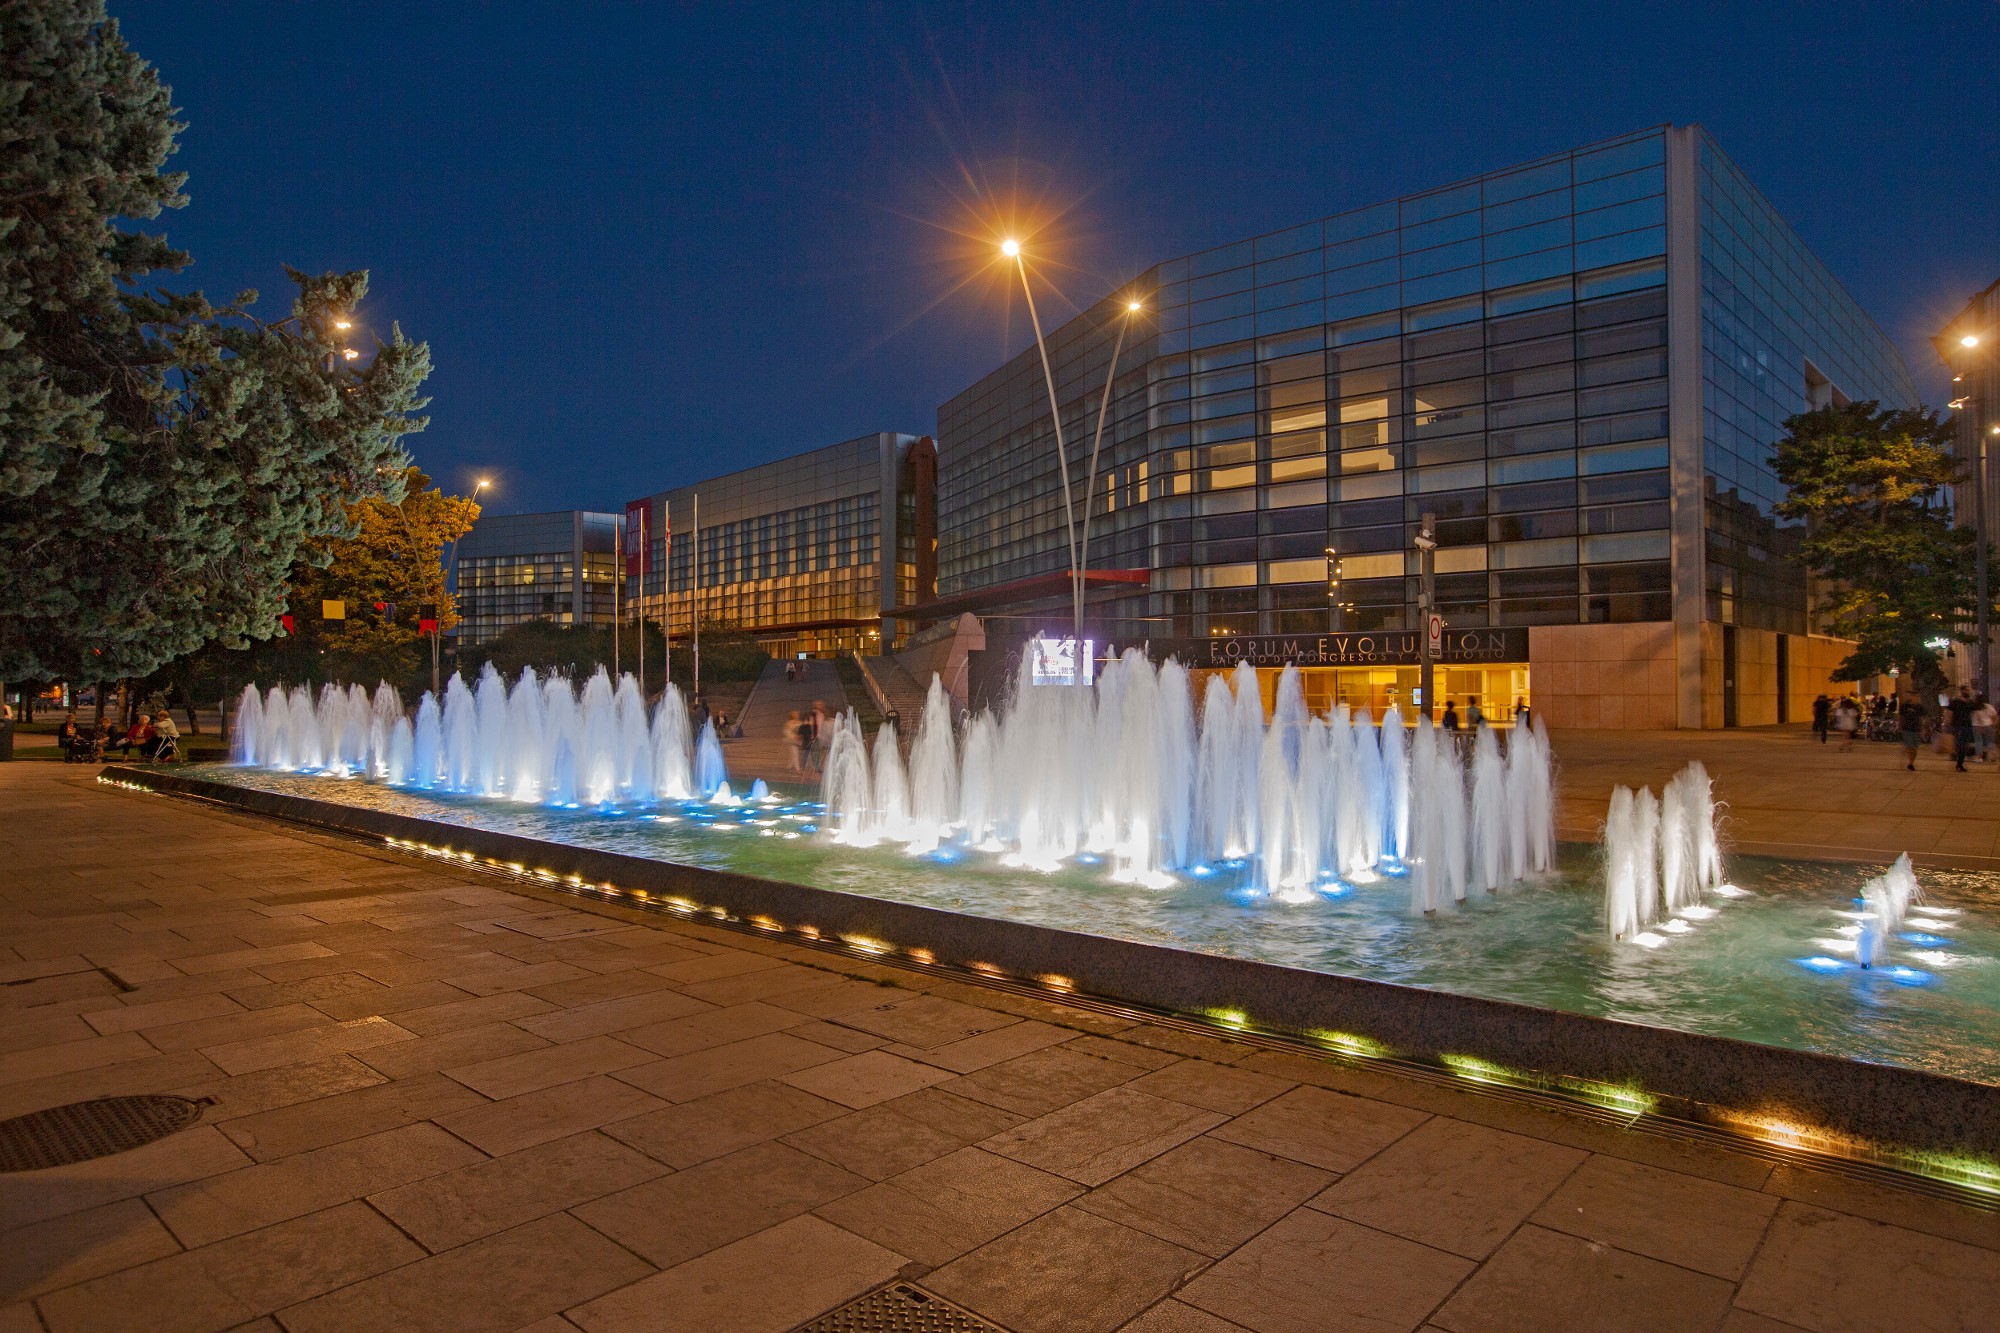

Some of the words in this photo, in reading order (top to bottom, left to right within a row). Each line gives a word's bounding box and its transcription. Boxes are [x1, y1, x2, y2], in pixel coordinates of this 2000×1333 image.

[1210, 639, 1298, 657] FÓRUM
[1318, 630, 1506, 655] EVOLUIÓN
[1298, 652, 1387, 663] CONGRESOS
